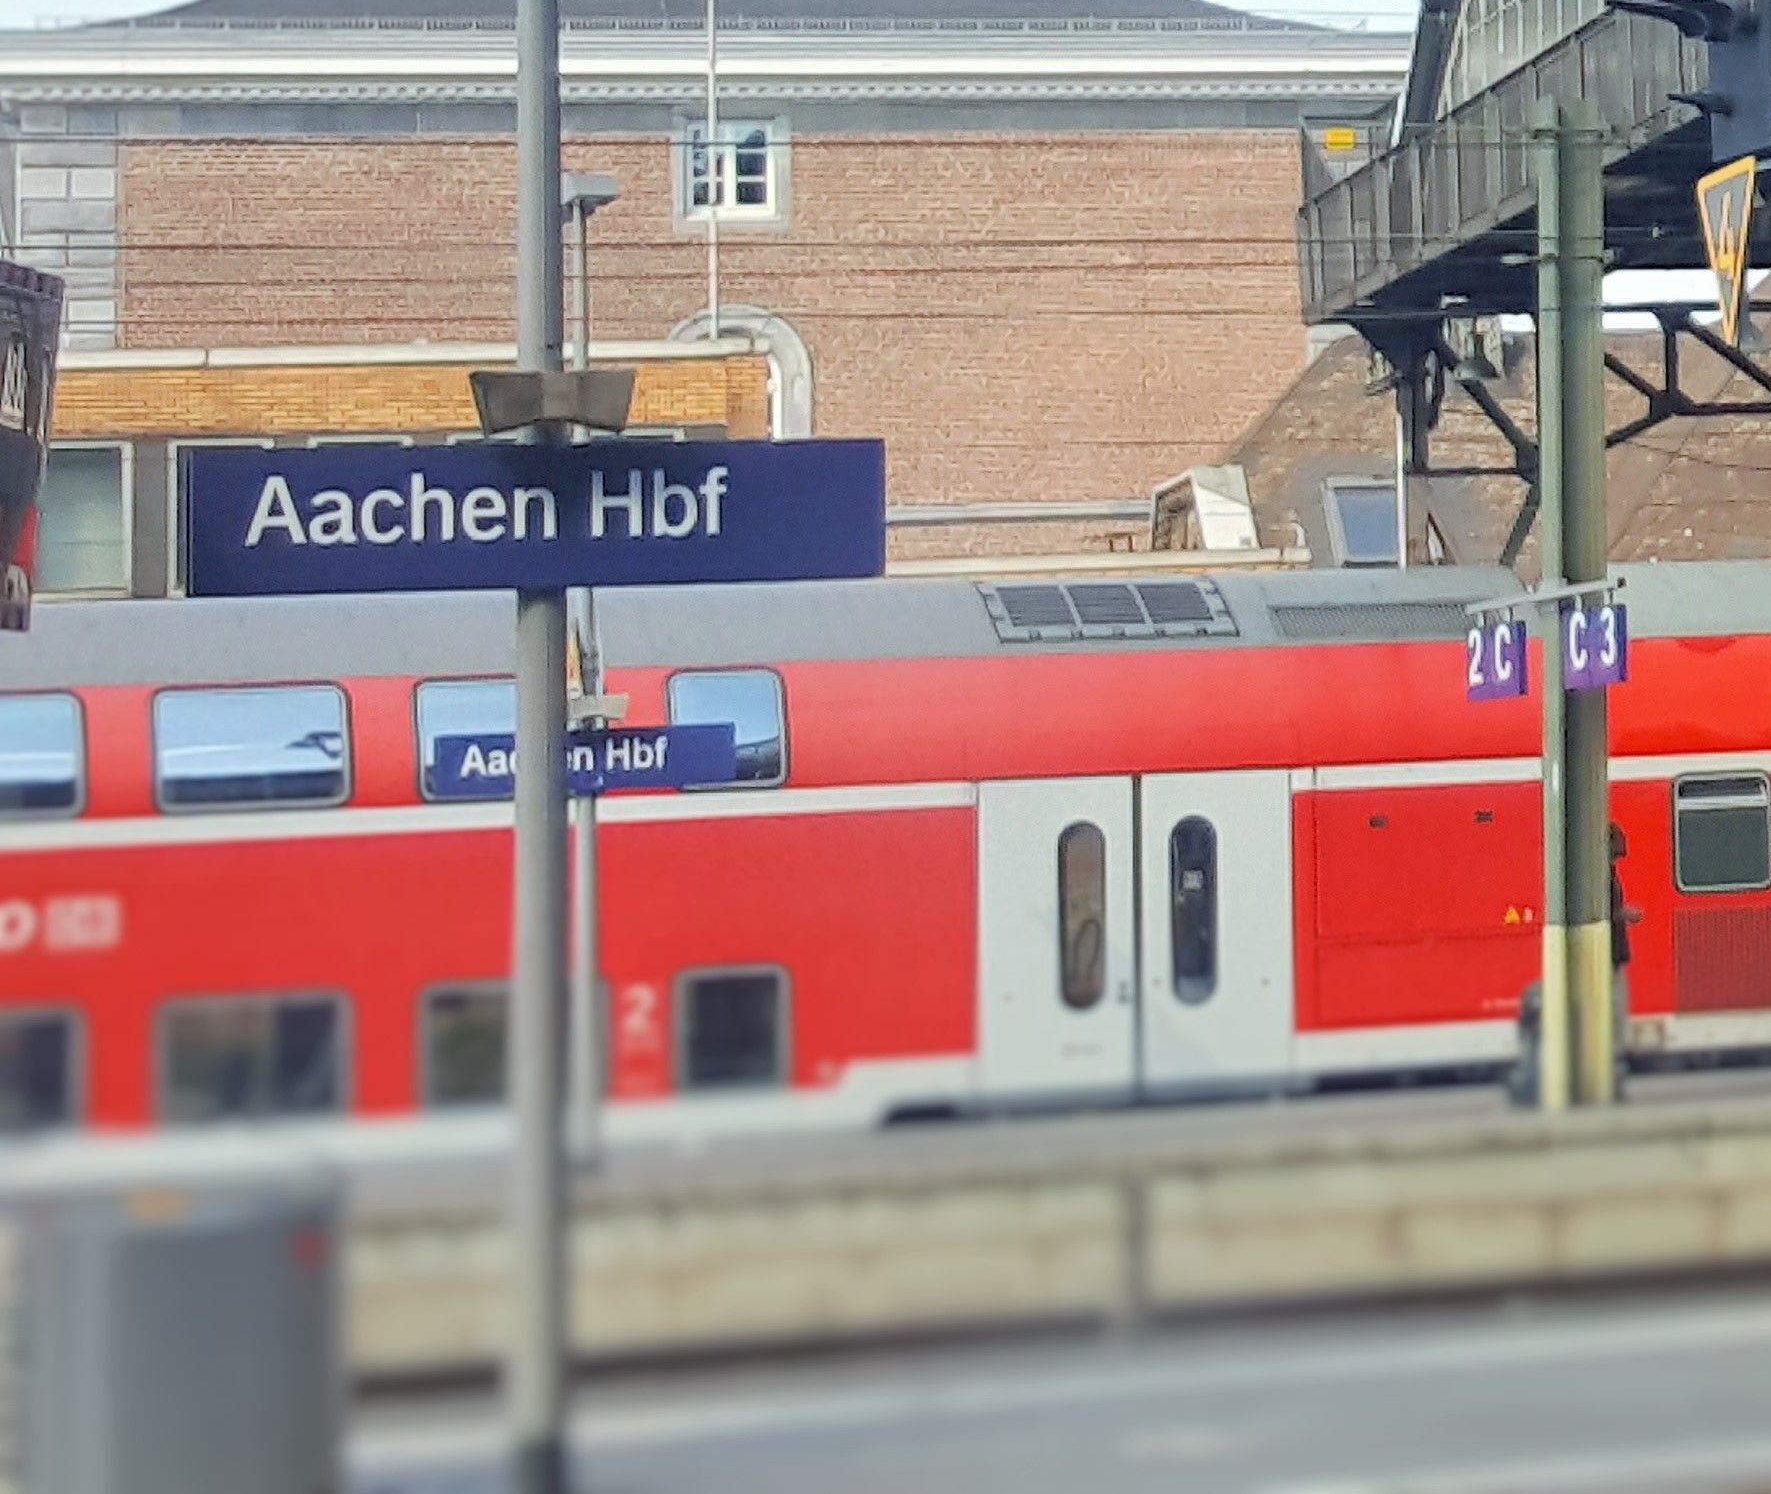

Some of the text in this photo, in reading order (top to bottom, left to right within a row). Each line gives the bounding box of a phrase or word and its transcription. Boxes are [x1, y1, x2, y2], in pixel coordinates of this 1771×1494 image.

[244, 466, 728, 547] Aachen Hbf
[1467, 623, 1512, 687] 2 C
[1568, 606, 1618, 672] C 3
[459, 735, 669, 779] Aan Hbf
